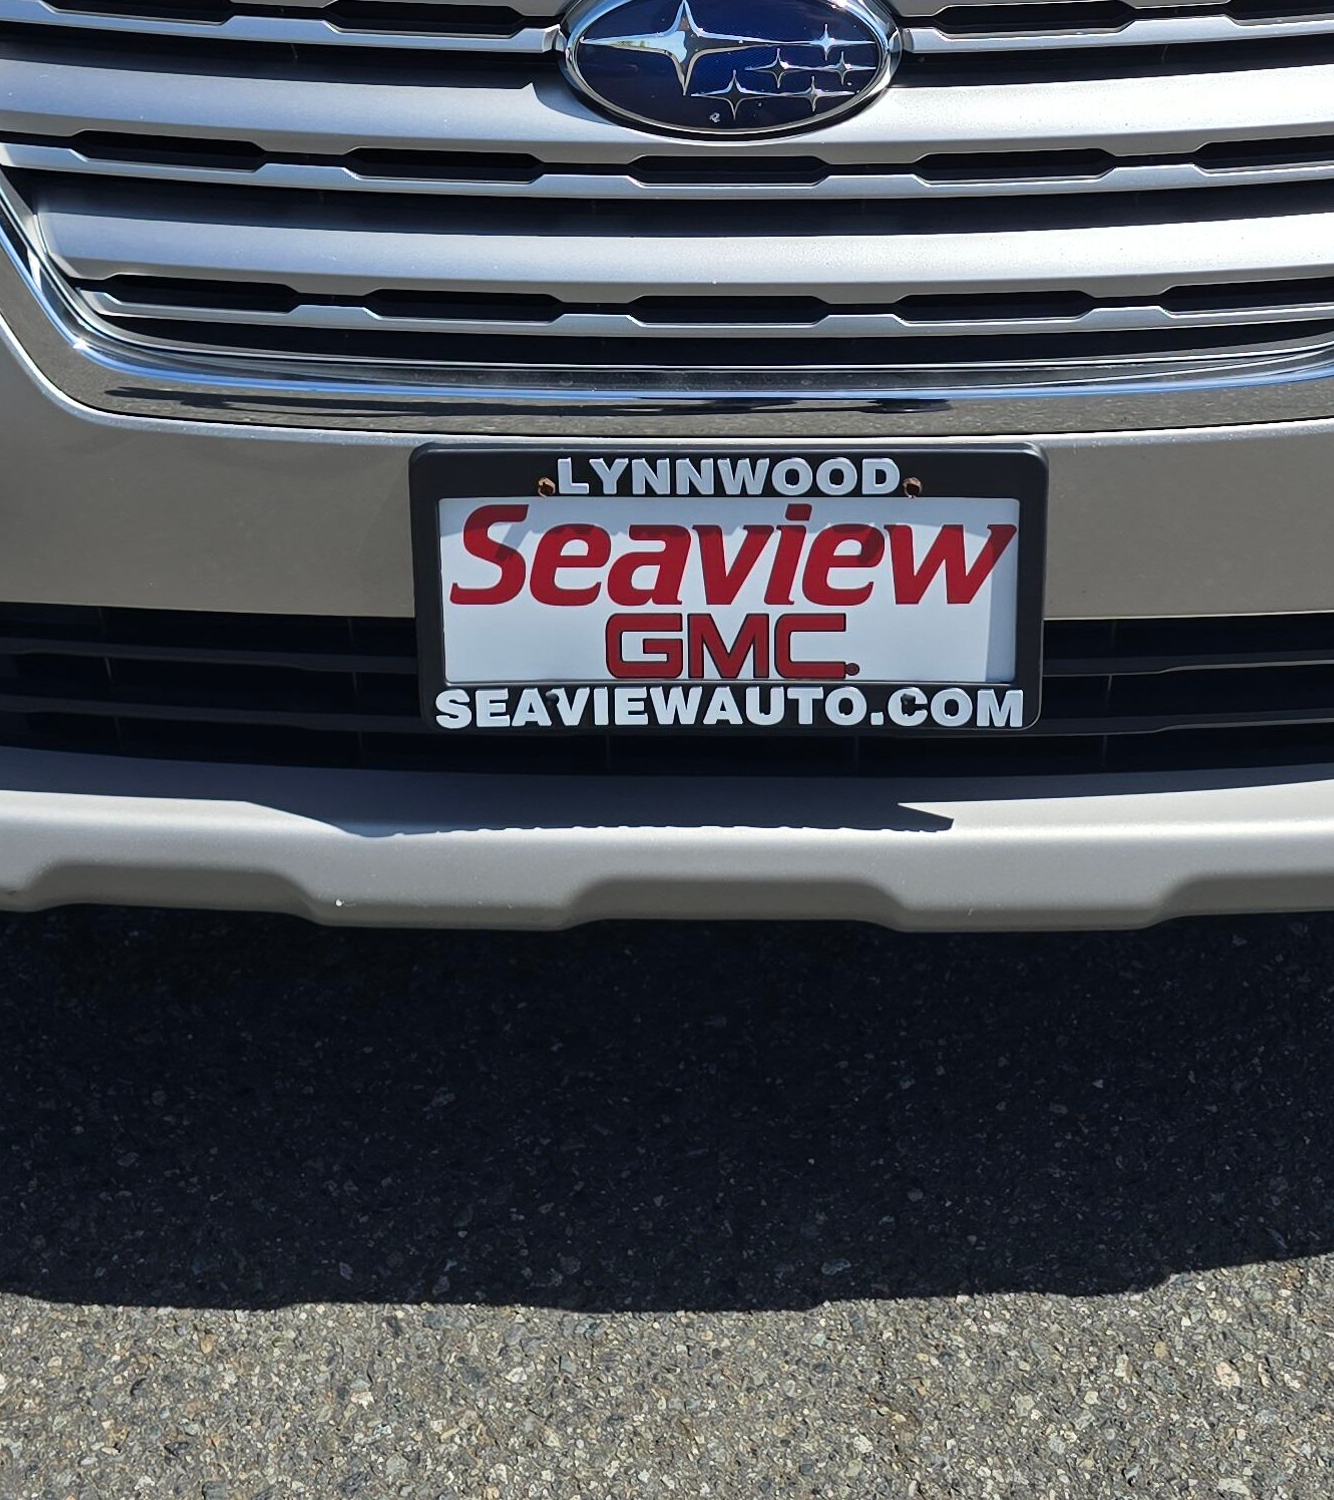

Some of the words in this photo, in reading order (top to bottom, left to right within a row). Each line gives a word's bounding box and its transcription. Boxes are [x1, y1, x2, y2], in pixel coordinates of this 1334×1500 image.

[557, 457, 902, 496] LYNNWOOD
[449, 503, 1019, 606] Seaview
[605, 613, 847, 679] GMC
[435, 686, 1024, 730] SEAVIEWAUTO.COM
